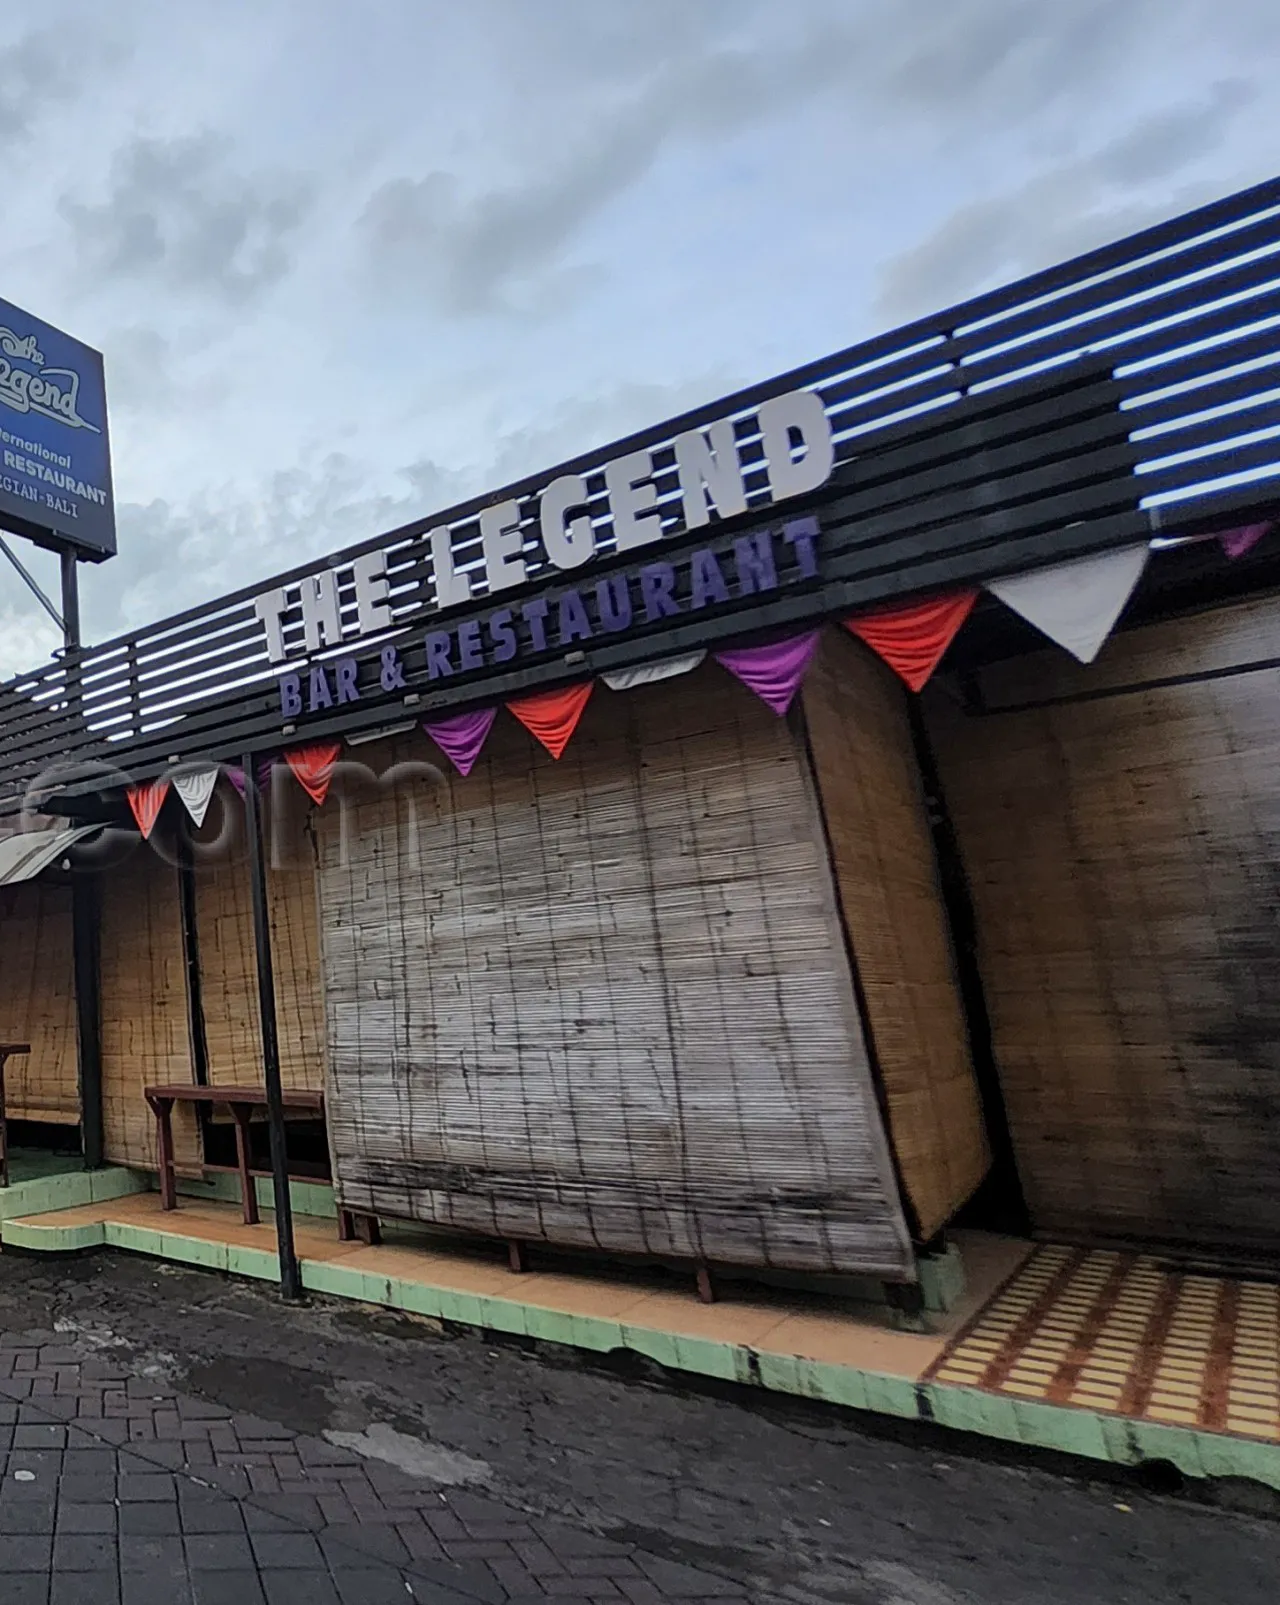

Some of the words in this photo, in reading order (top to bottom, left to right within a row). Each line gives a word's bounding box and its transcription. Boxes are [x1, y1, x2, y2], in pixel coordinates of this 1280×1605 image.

[4, 453, 107, 506] RESTAURANT
[255, 549, 393, 664] THE
[431, 390, 835, 608] LEGEND
[280, 652, 359, 718] BAR
[381, 645, 406, 692] &
[426, 518, 819, 680] RESTAURANT
